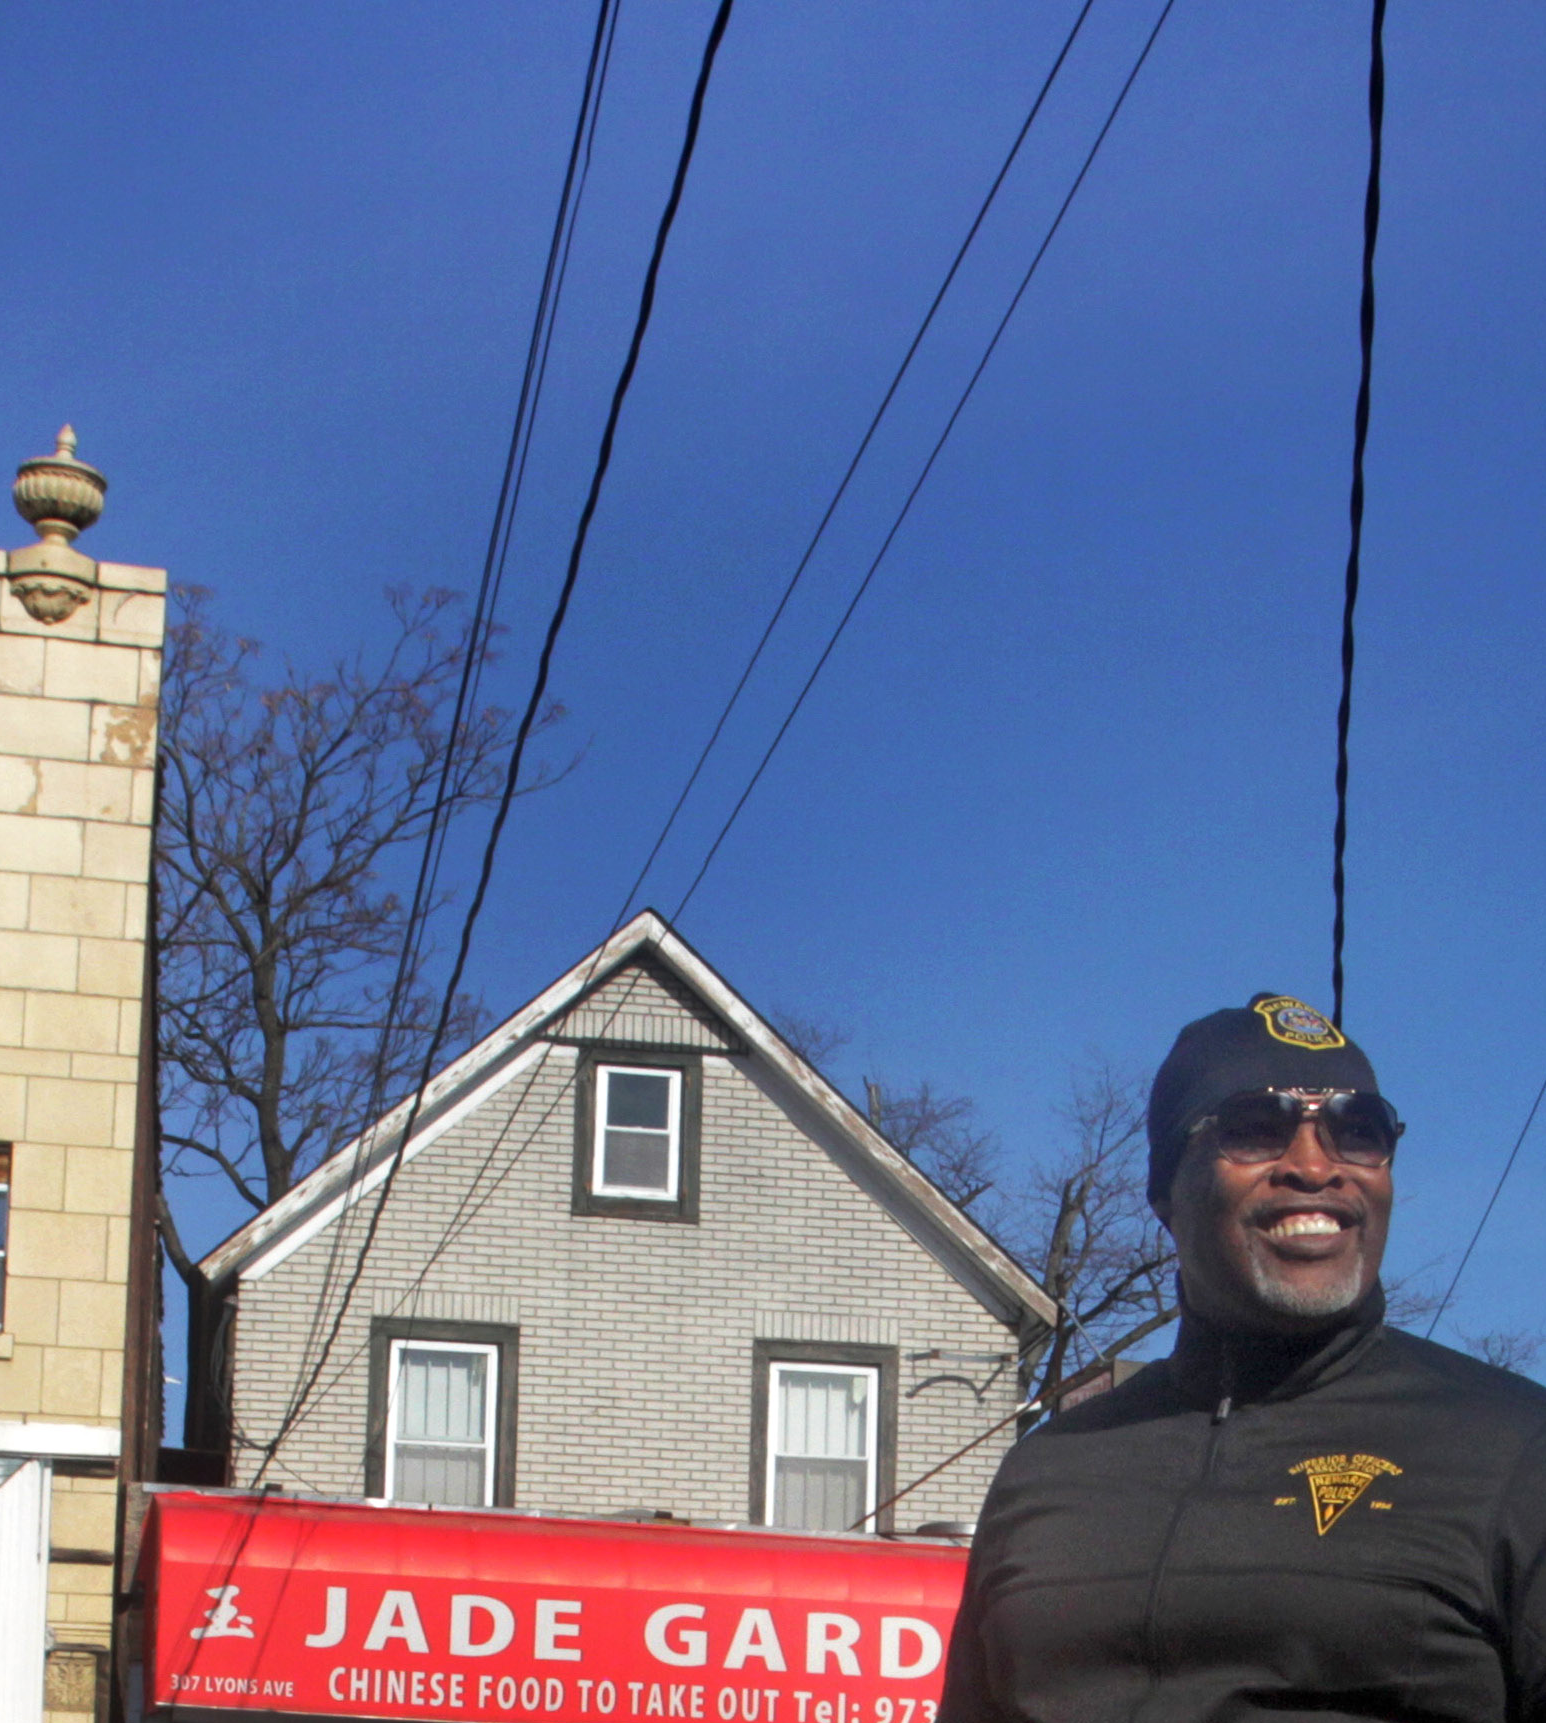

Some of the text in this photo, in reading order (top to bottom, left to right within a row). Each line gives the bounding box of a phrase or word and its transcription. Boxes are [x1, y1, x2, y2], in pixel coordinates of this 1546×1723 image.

[1318, 1486, 1357, 1499] POLICE
[305, 1586, 943, 1680] JADE GARD
[170, 1673, 294, 1698] 307 LYONS AVE
[328, 1666, 464, 1708] CHINESE
[478, 1674, 565, 1712] FOOD
[576, 1679, 617, 1714] TO
[628, 1682, 705, 1719] TAKE
[717, 1687, 780, 1722] OUT
